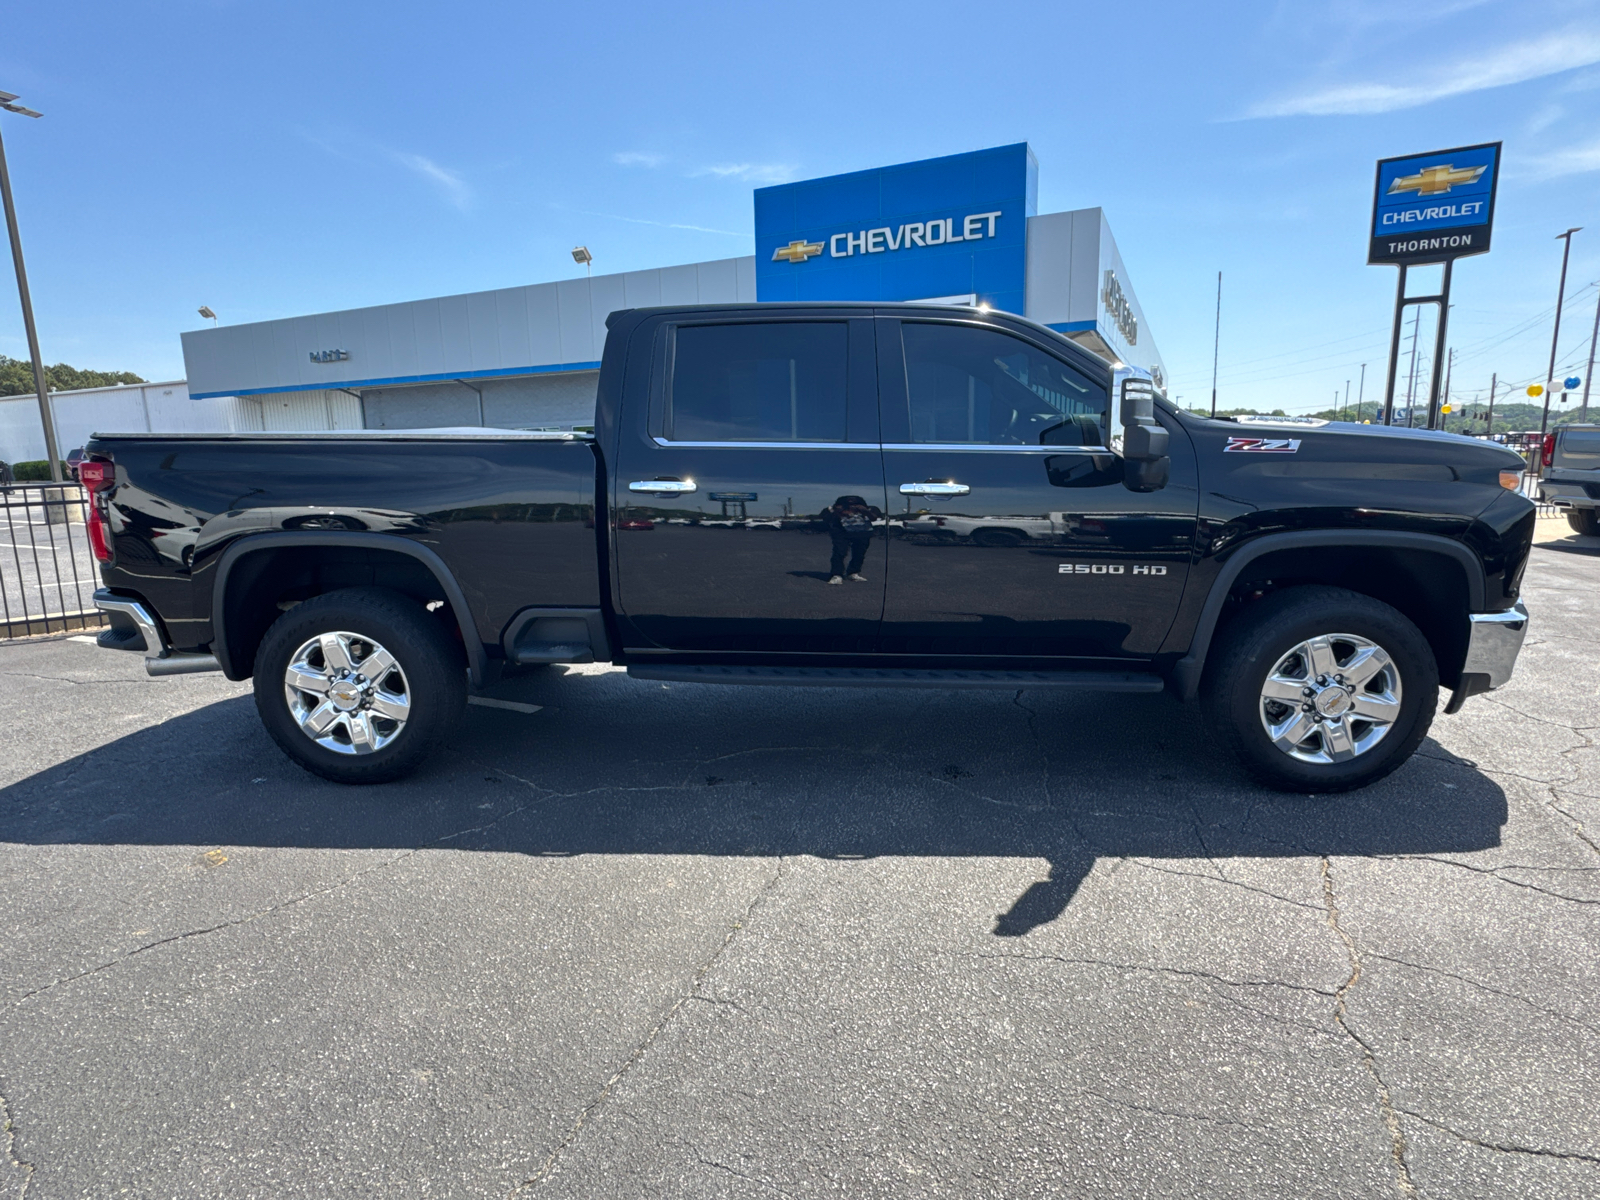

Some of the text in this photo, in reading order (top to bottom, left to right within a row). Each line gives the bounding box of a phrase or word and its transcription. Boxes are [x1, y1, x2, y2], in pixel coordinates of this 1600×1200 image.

[1383, 202, 1483, 225] CHEVROLET
[830, 211, 1002, 258] CHEVROLET
[1388, 234, 1472, 253] THORNTON
[309, 348, 348, 363] PARTS
[1223, 437, 1302, 453] Z71
[1058, 564, 1167, 575] 2500 HD
